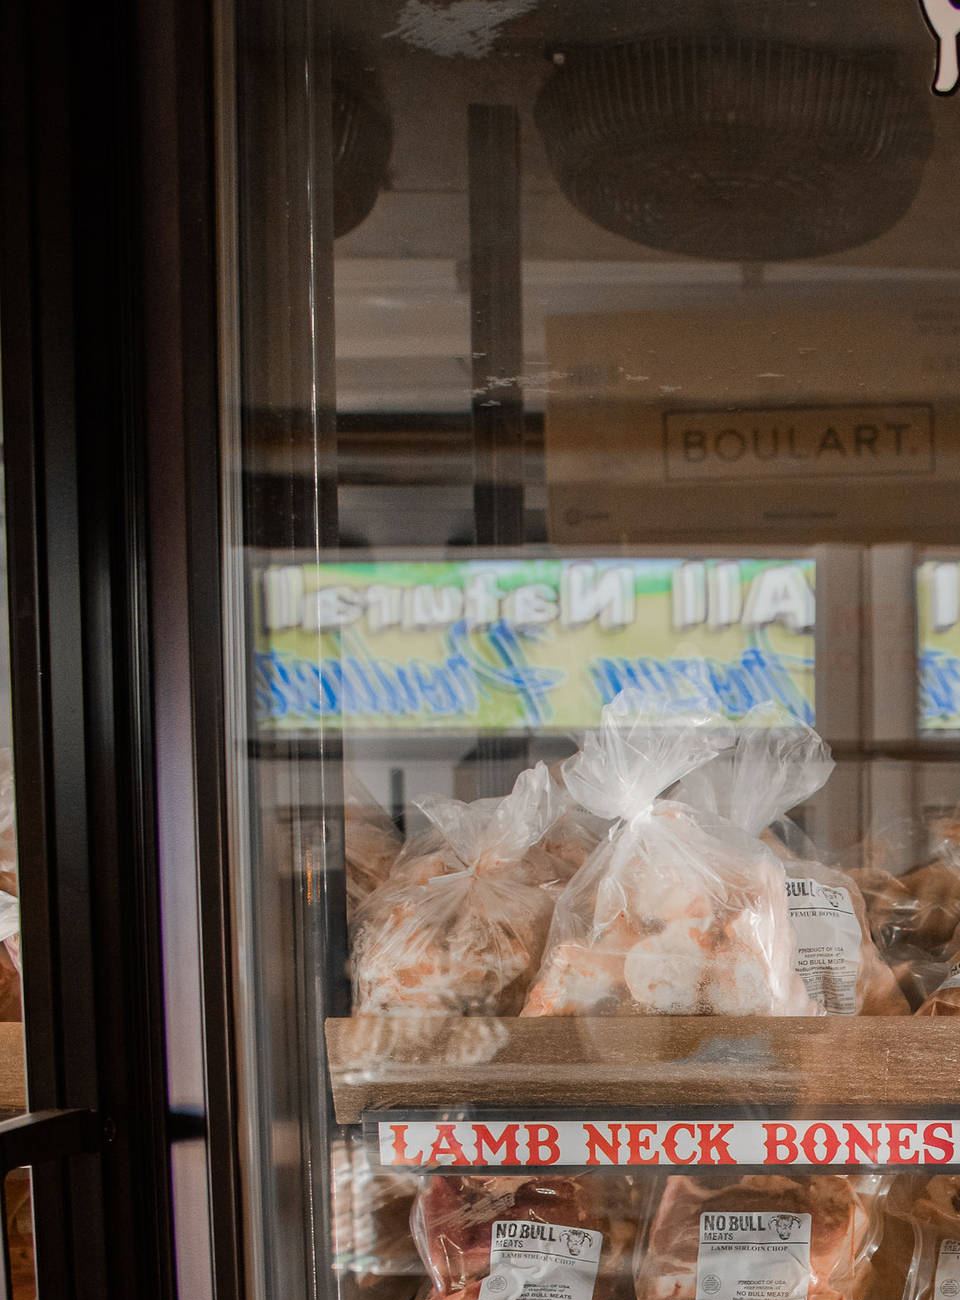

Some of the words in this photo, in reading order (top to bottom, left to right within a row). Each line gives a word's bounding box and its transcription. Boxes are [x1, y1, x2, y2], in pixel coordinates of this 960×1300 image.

[390, 1123, 561, 1166] LAMB
[583, 1123, 737, 1165] NECK
[762, 1122, 955, 1165] BONES
[704, 1215, 726, 1231] NO
[728, 1215, 766, 1231] BULL
[496, 1223, 517, 1239] NO
[520, 1224, 557, 1242] BULL
[704, 1232, 733, 1240] MEATS
